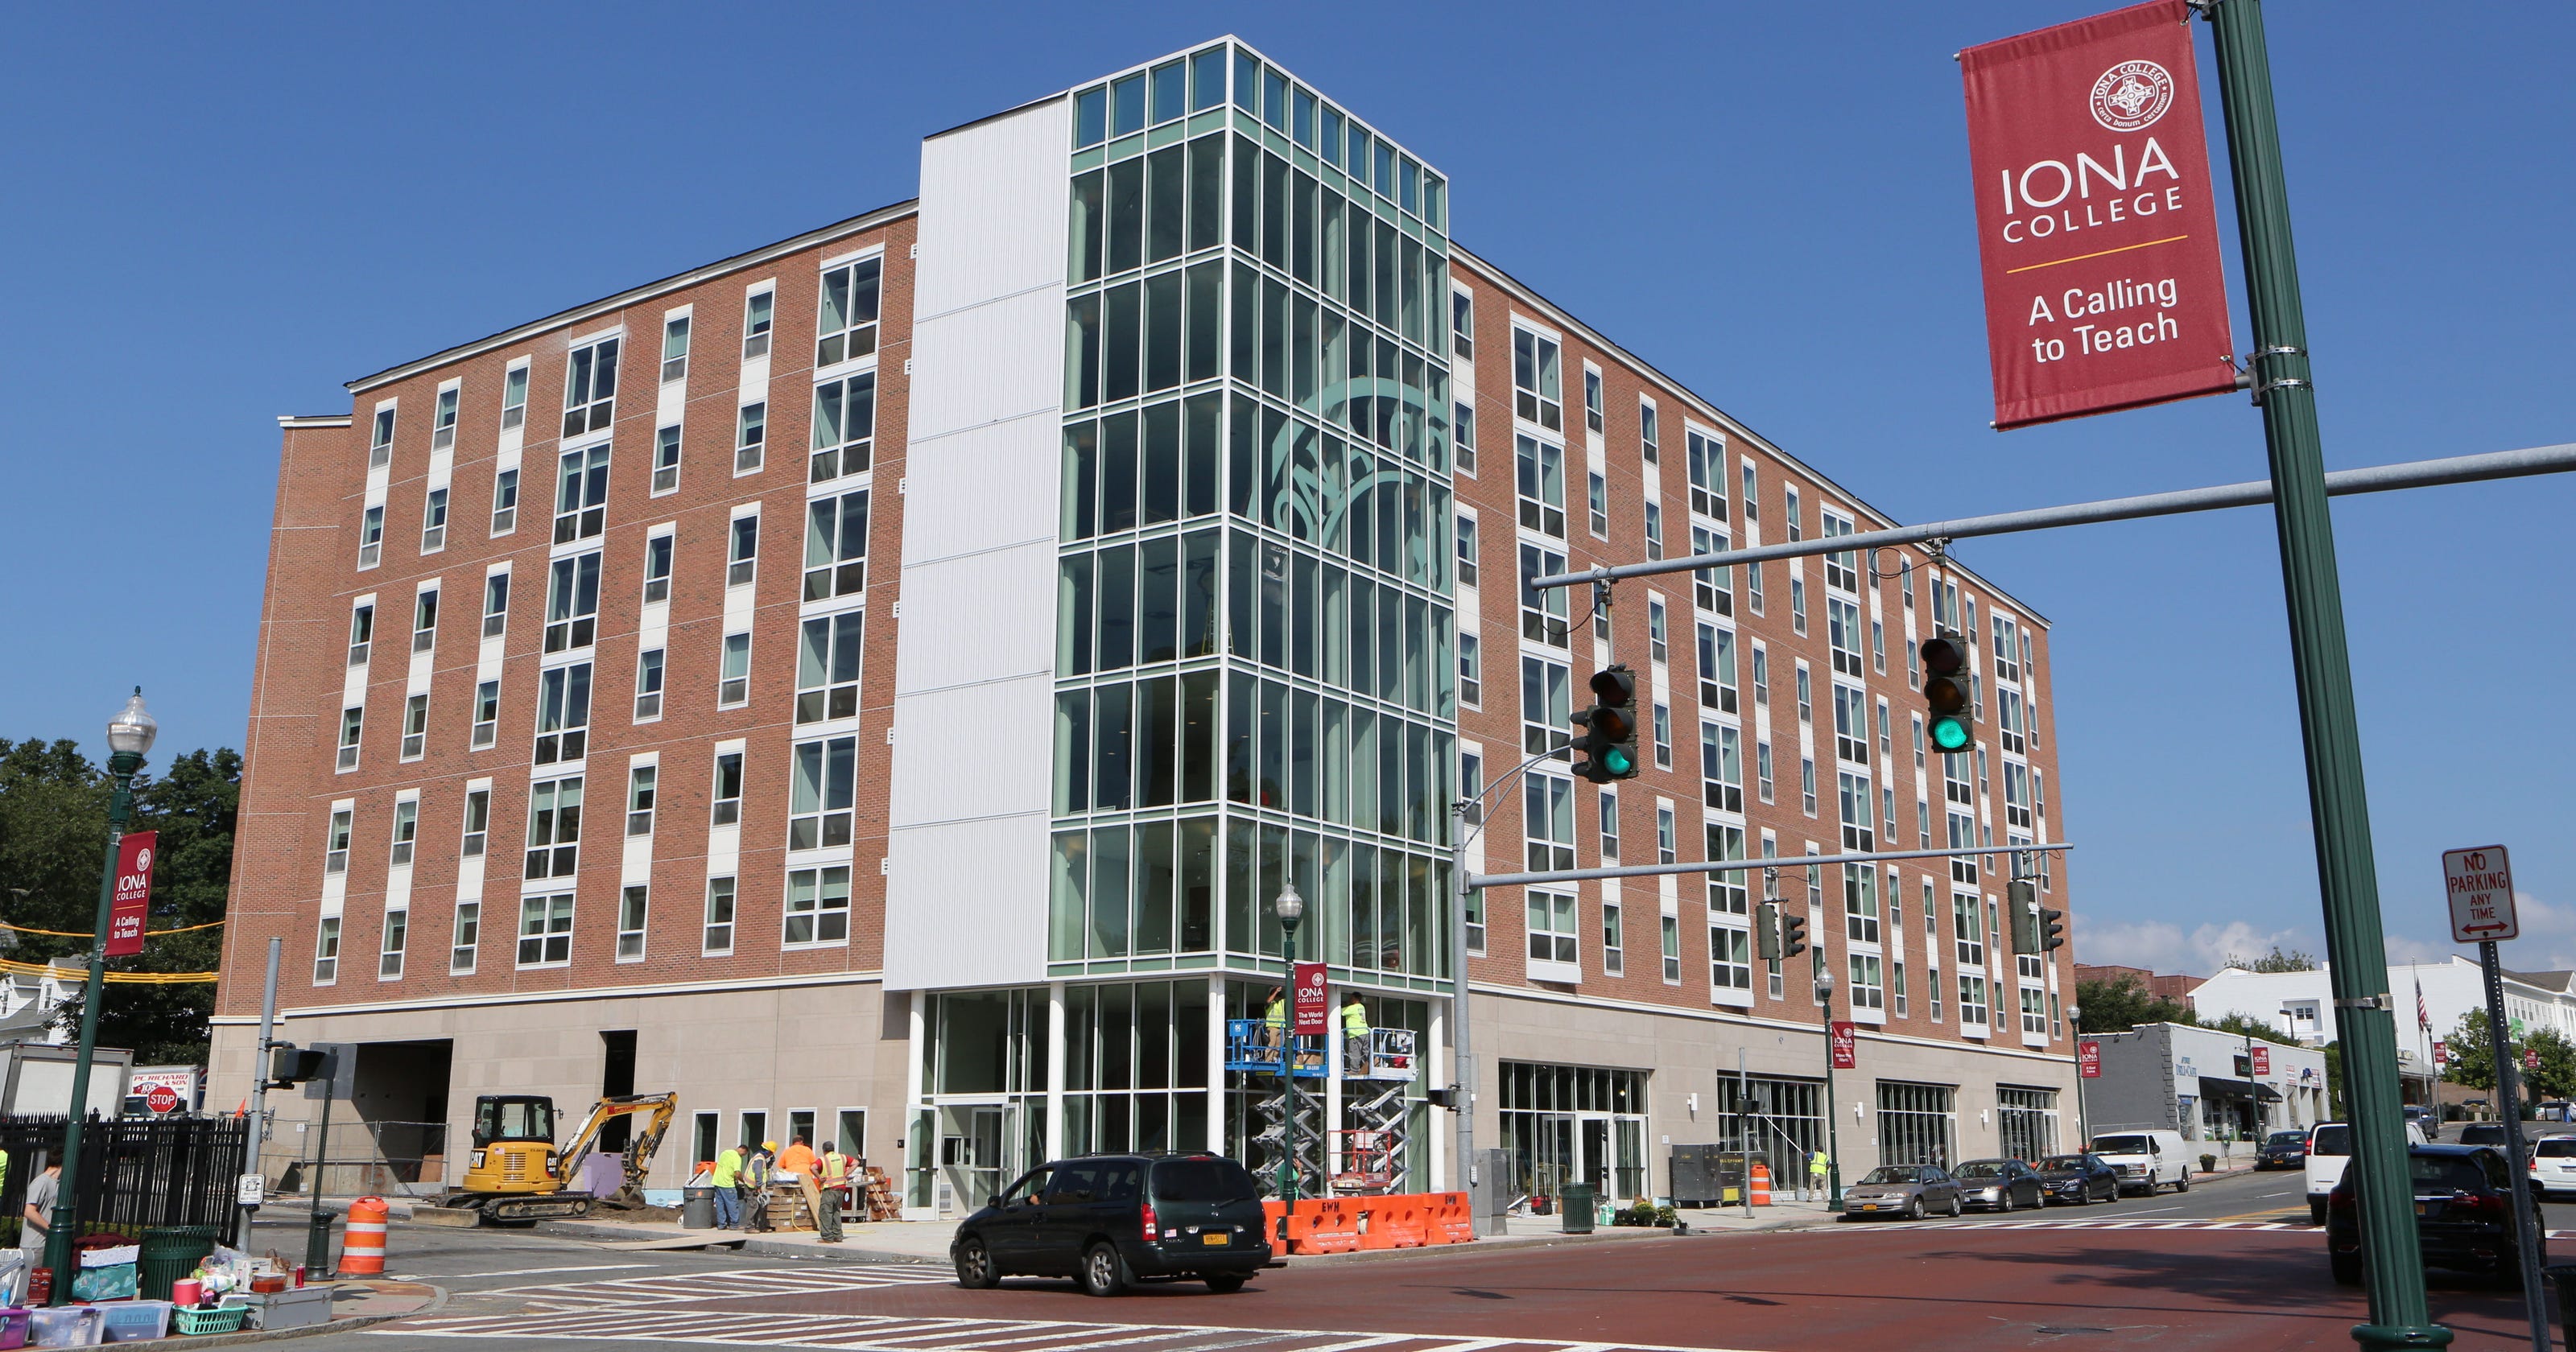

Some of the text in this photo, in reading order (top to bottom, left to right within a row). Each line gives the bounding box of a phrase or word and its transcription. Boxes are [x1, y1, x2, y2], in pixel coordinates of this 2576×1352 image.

[2095, 64, 2167, 99] IONA COLLEGE
[2098, 93, 2167, 127] certa bonum certamen
[2002, 137, 2179, 215] IONA
[2002, 187, 2182, 243] COLLEGE
[2029, 278, 2178, 327] A Calling
[2032, 311, 2178, 364] to Teach
[2463, 853, 2487, 872] NO
[118, 873, 147, 892] IONA
[2450, 872, 2506, 893] PARKING
[116, 890, 146, 901] COLLEGE
[2470, 893, 2491, 906] ANY
[2470, 907, 2496, 920] TIME
[115, 916, 140, 927] A Calling
[114, 928, 138, 939] to Teach
[1298, 987, 1323, 998] IONA
[1834, 1037, 1852, 1045] IONA
[150, 1094, 175, 1105] STOP
[547, 1157, 557, 1166] CAT
[1445, 1194, 1456, 1205] EWH
[1322, 1201, 1340, 1213] EWH
